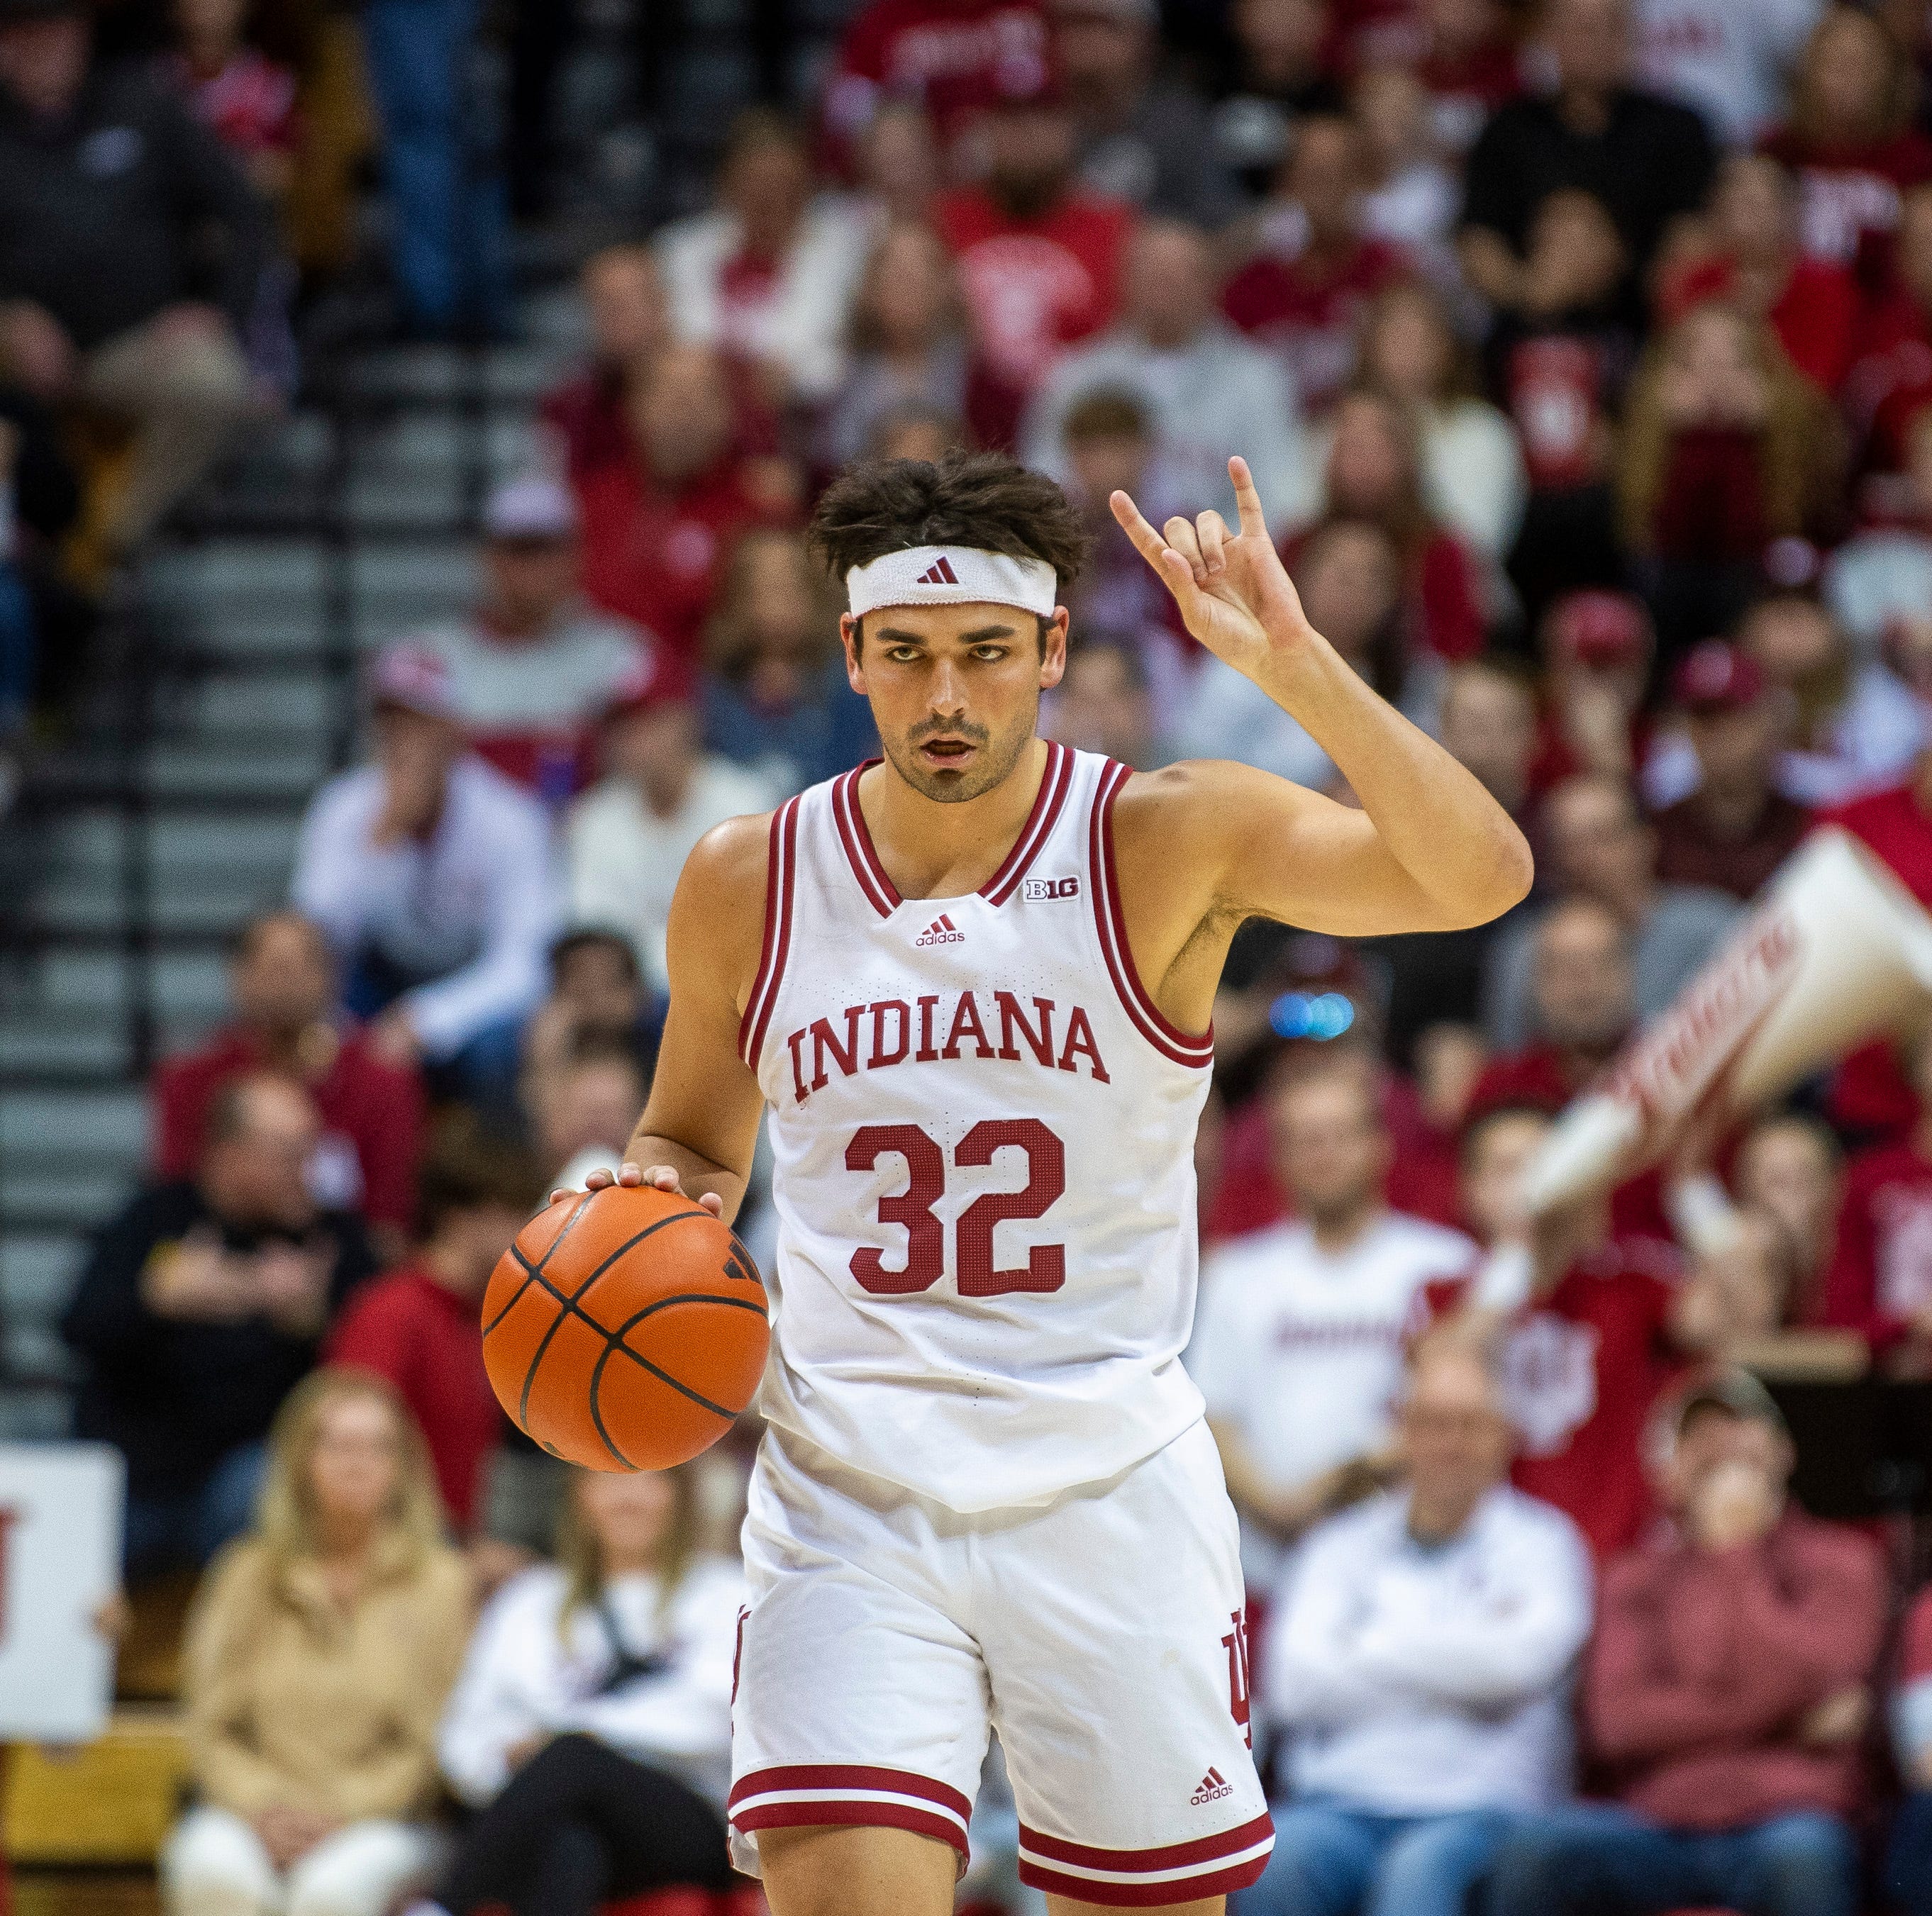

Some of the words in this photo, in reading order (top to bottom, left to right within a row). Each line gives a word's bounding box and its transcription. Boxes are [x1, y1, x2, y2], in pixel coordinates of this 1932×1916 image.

[916, 932, 965, 947] adidas
[787, 991, 1111, 1104] INDIANA
[845, 1118, 1065, 1297] 32
[1190, 1784, 1233, 1806] adidas
